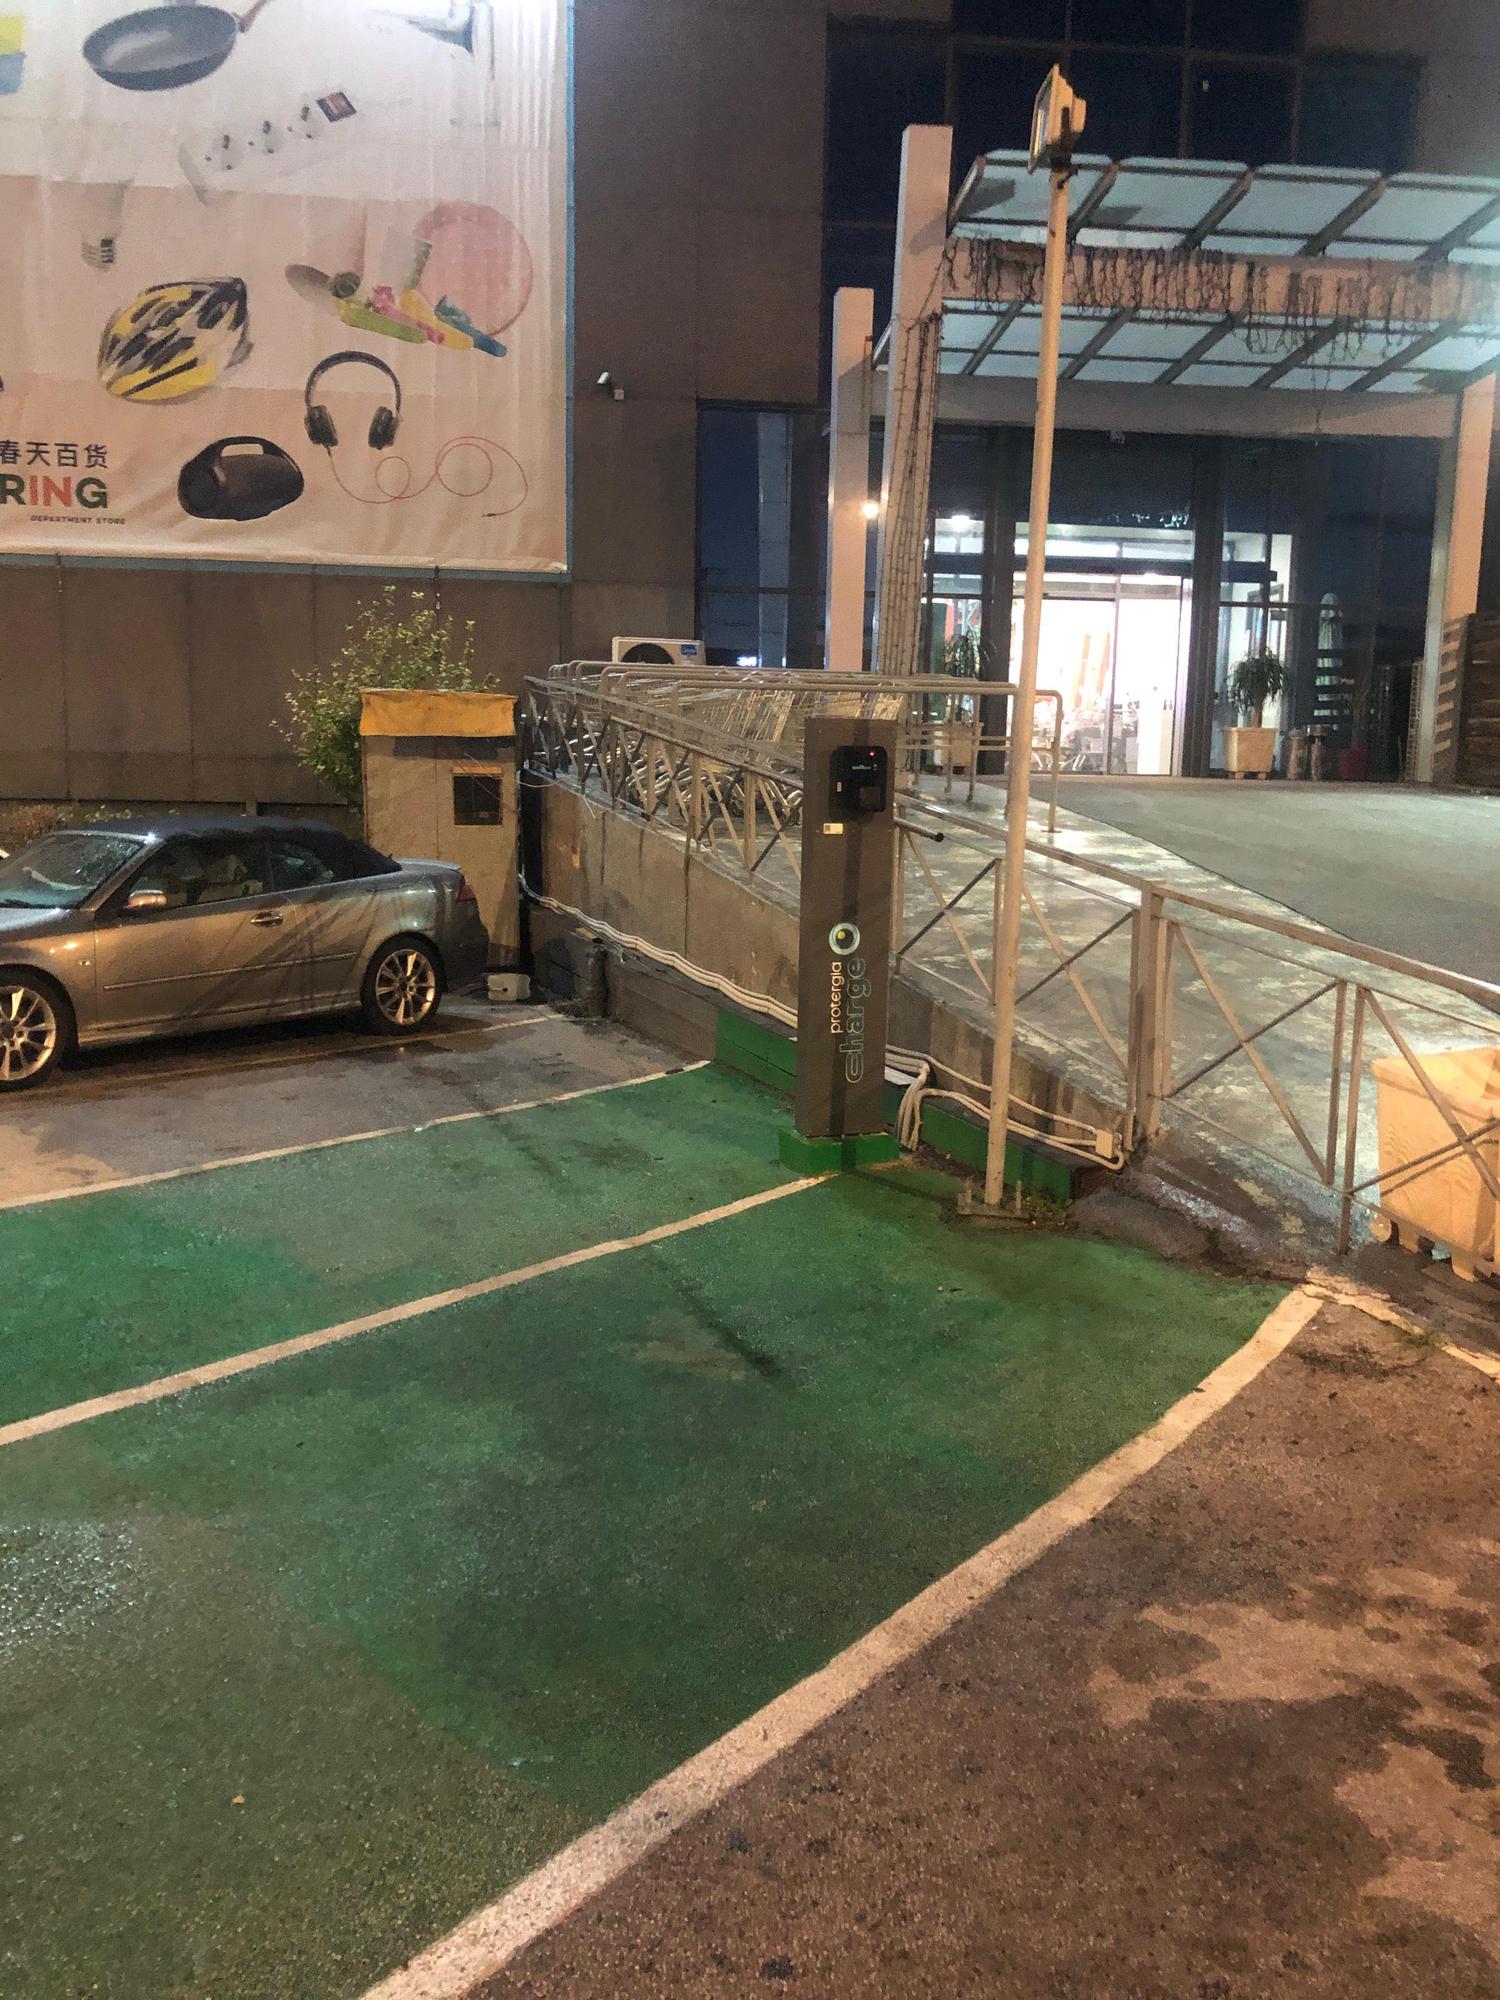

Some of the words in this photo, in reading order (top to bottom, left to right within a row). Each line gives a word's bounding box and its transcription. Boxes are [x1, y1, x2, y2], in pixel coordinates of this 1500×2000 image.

[0, 440, 107, 468] 春天百货
[0, 474, 107, 508] RING
[96, 517, 125, 525] STORE
[831, 961, 845, 1034] protergia
[839, 957, 872, 1083] charge
